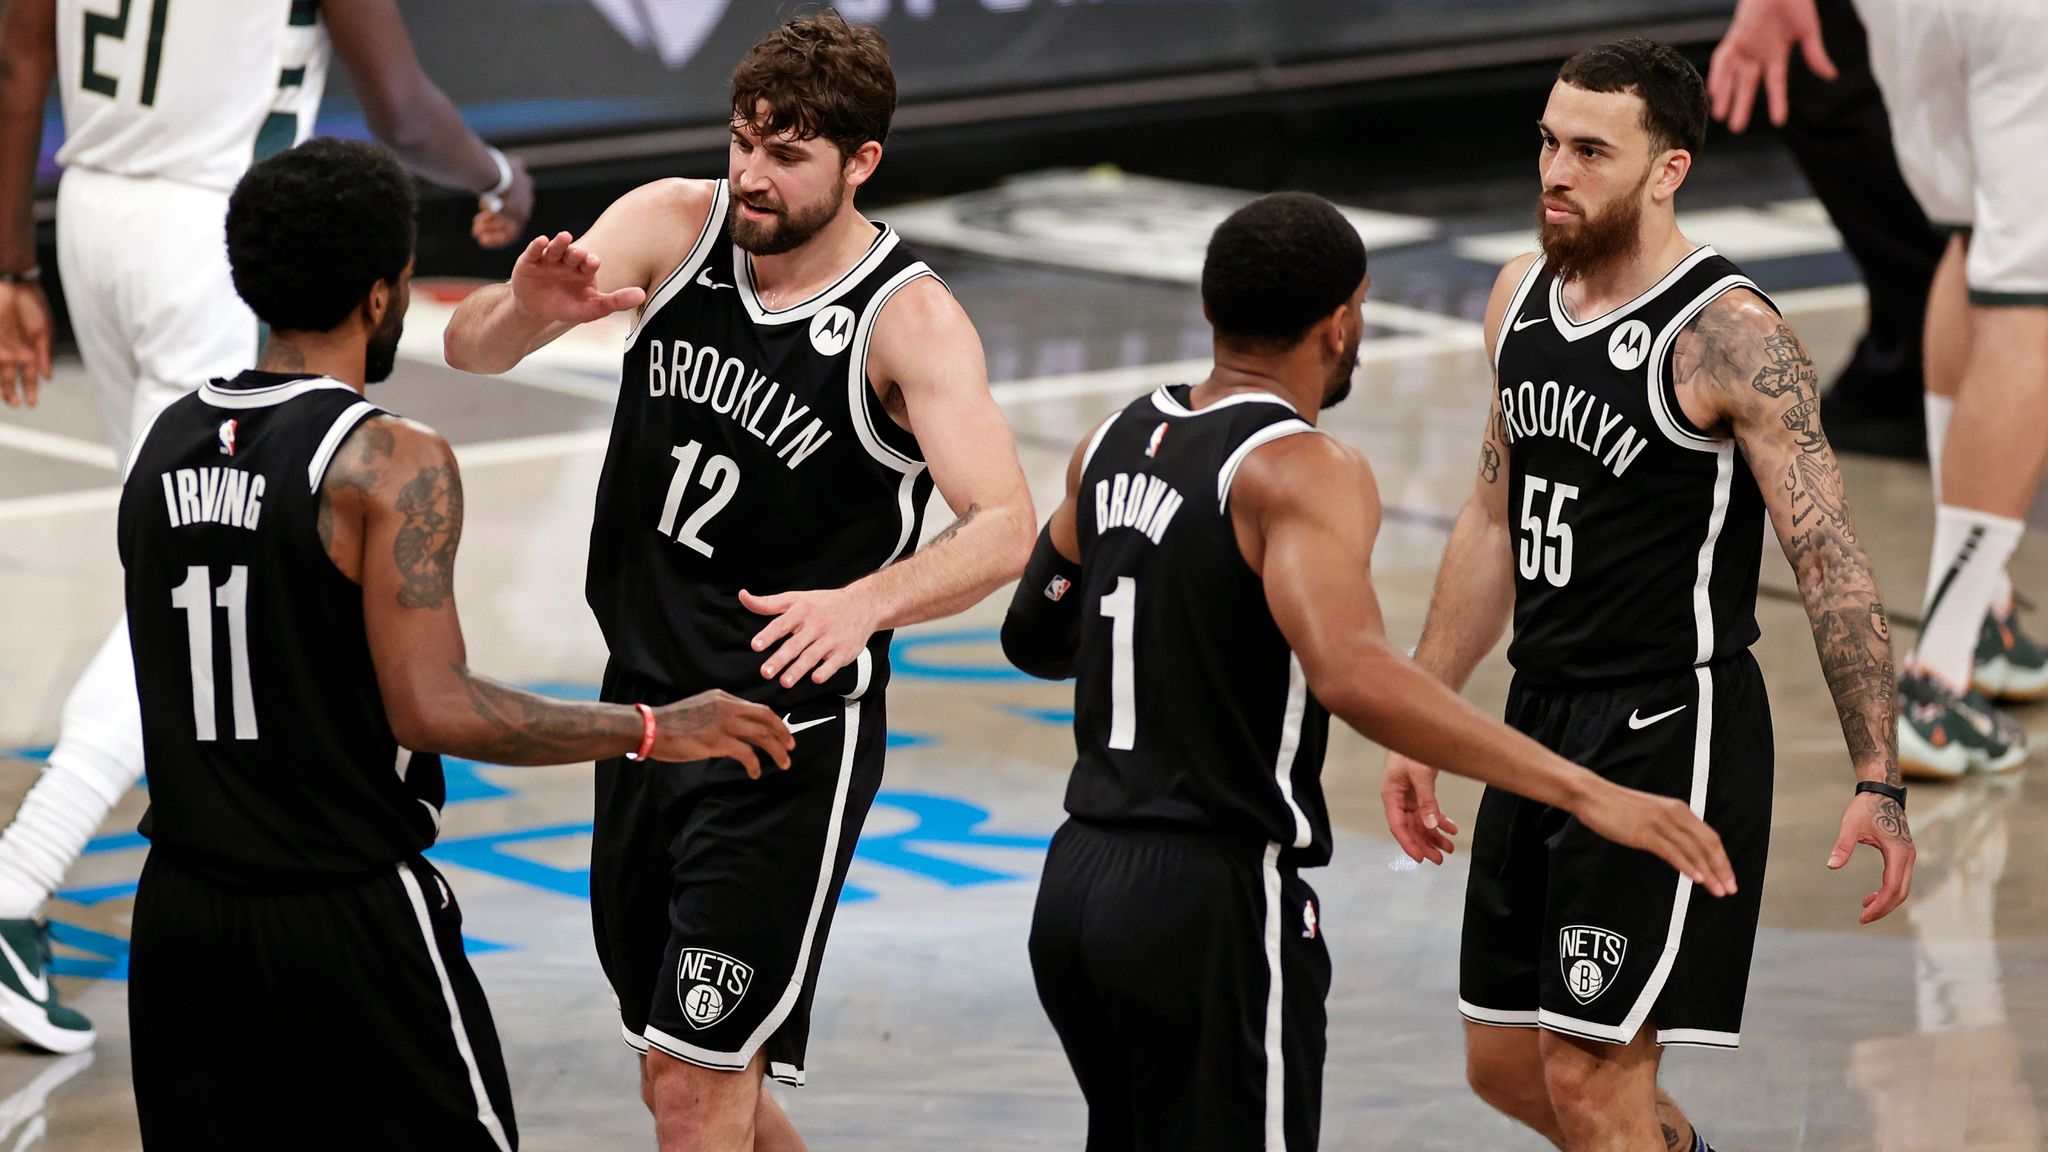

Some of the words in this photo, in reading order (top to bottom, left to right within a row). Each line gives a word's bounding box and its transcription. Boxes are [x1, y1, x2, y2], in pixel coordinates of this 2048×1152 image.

[81, 0, 168, 107] 21
[649, 339, 833, 470] BROOKLYN
[1501, 380, 1648, 478] ROOKLYN
[161, 466, 266, 531] IRVING
[657, 439, 741, 559] 12
[1095, 472, 1184, 545] BROWN
[1519, 474, 1580, 588] 55
[171, 565, 259, 741] 11
[1099, 576, 1137, 751] 1
[680, 952, 747, 995] NETS
[1562, 929, 1621, 965] NETS
[1579, 964, 1591, 993] B
[695, 989, 712, 1018] B
